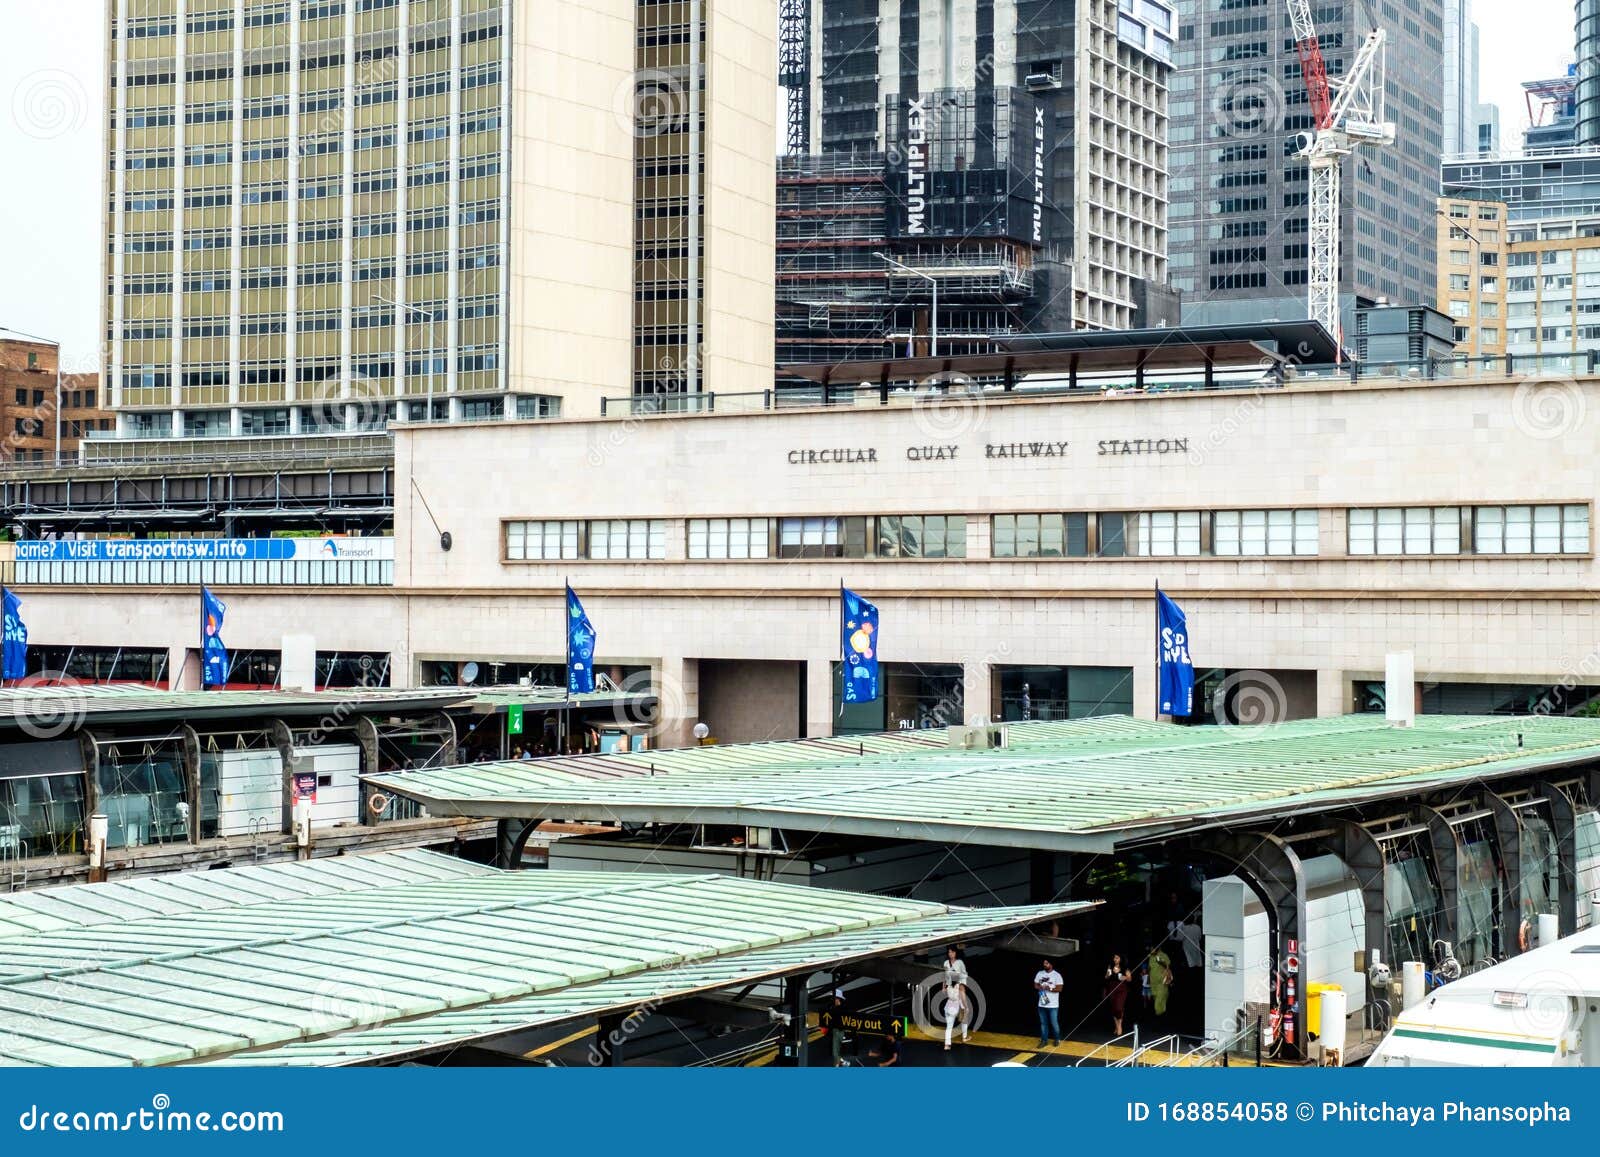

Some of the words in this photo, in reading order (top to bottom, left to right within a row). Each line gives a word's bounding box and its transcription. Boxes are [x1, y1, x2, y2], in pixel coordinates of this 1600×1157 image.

[908, 98, 925, 234] MULTIPLEX
[1032, 107, 1044, 242] MULTIPLEX
[788, 448, 878, 464] CIRCULAR
[906, 446, 959, 461] QUAY
[985, 442, 1069, 459] RAILWAY
[1097, 438, 1189, 456] STATION
[67, 541, 97, 557] Visit
[105, 540, 247, 560] transportnsw.info
[338, 547, 373, 558] Transport
[513, 718, 521, 731] 4
[841, 1015, 862, 1029] Way
[864, 1019, 882, 1030] out
